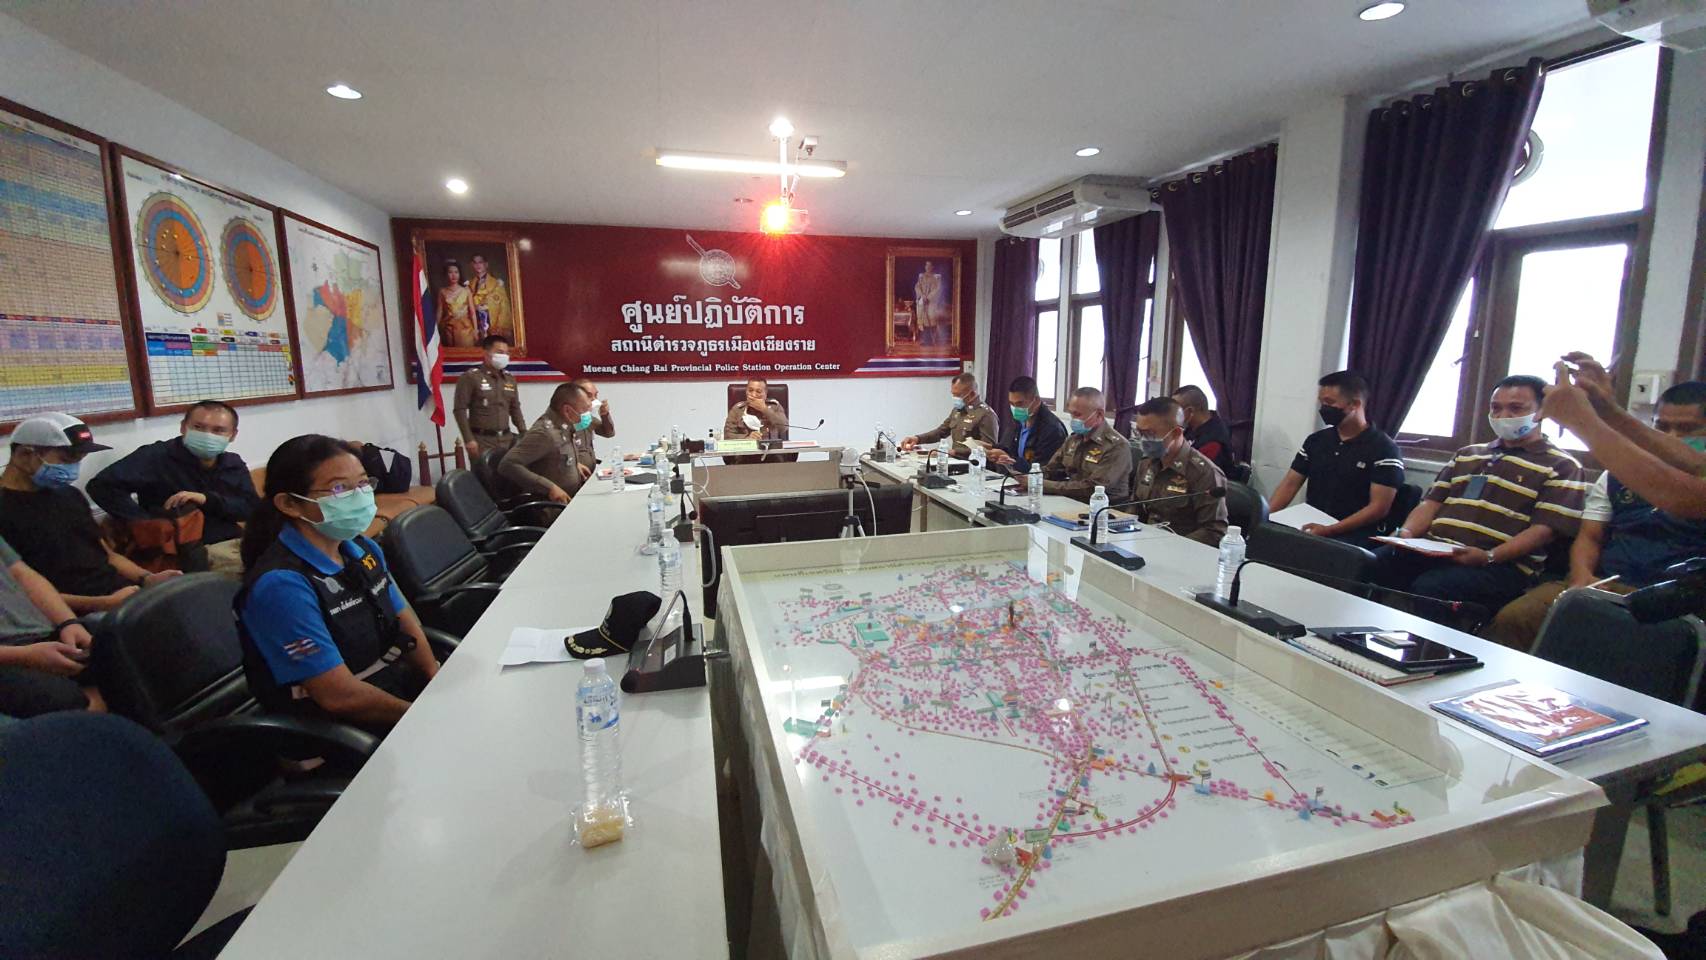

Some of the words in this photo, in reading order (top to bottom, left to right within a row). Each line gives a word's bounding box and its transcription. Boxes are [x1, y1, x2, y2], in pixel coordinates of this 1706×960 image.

[621, 294, 805, 333] ศูนย์ปฏิบัติการ
[611, 335, 816, 357] สถานีตำรวจภูธรเมืองเชียงราย
[583, 364, 618, 375] Mueang
[620, 364, 650, 374] Chiang
[653, 364, 668, 372] Rai
[671, 363, 712, 372] Provincial
[715, 363, 739, 372] Police
[742, 363, 771, 371] Station
[774, 362, 812, 373] Operation
[815, 362, 841, 370] Center
